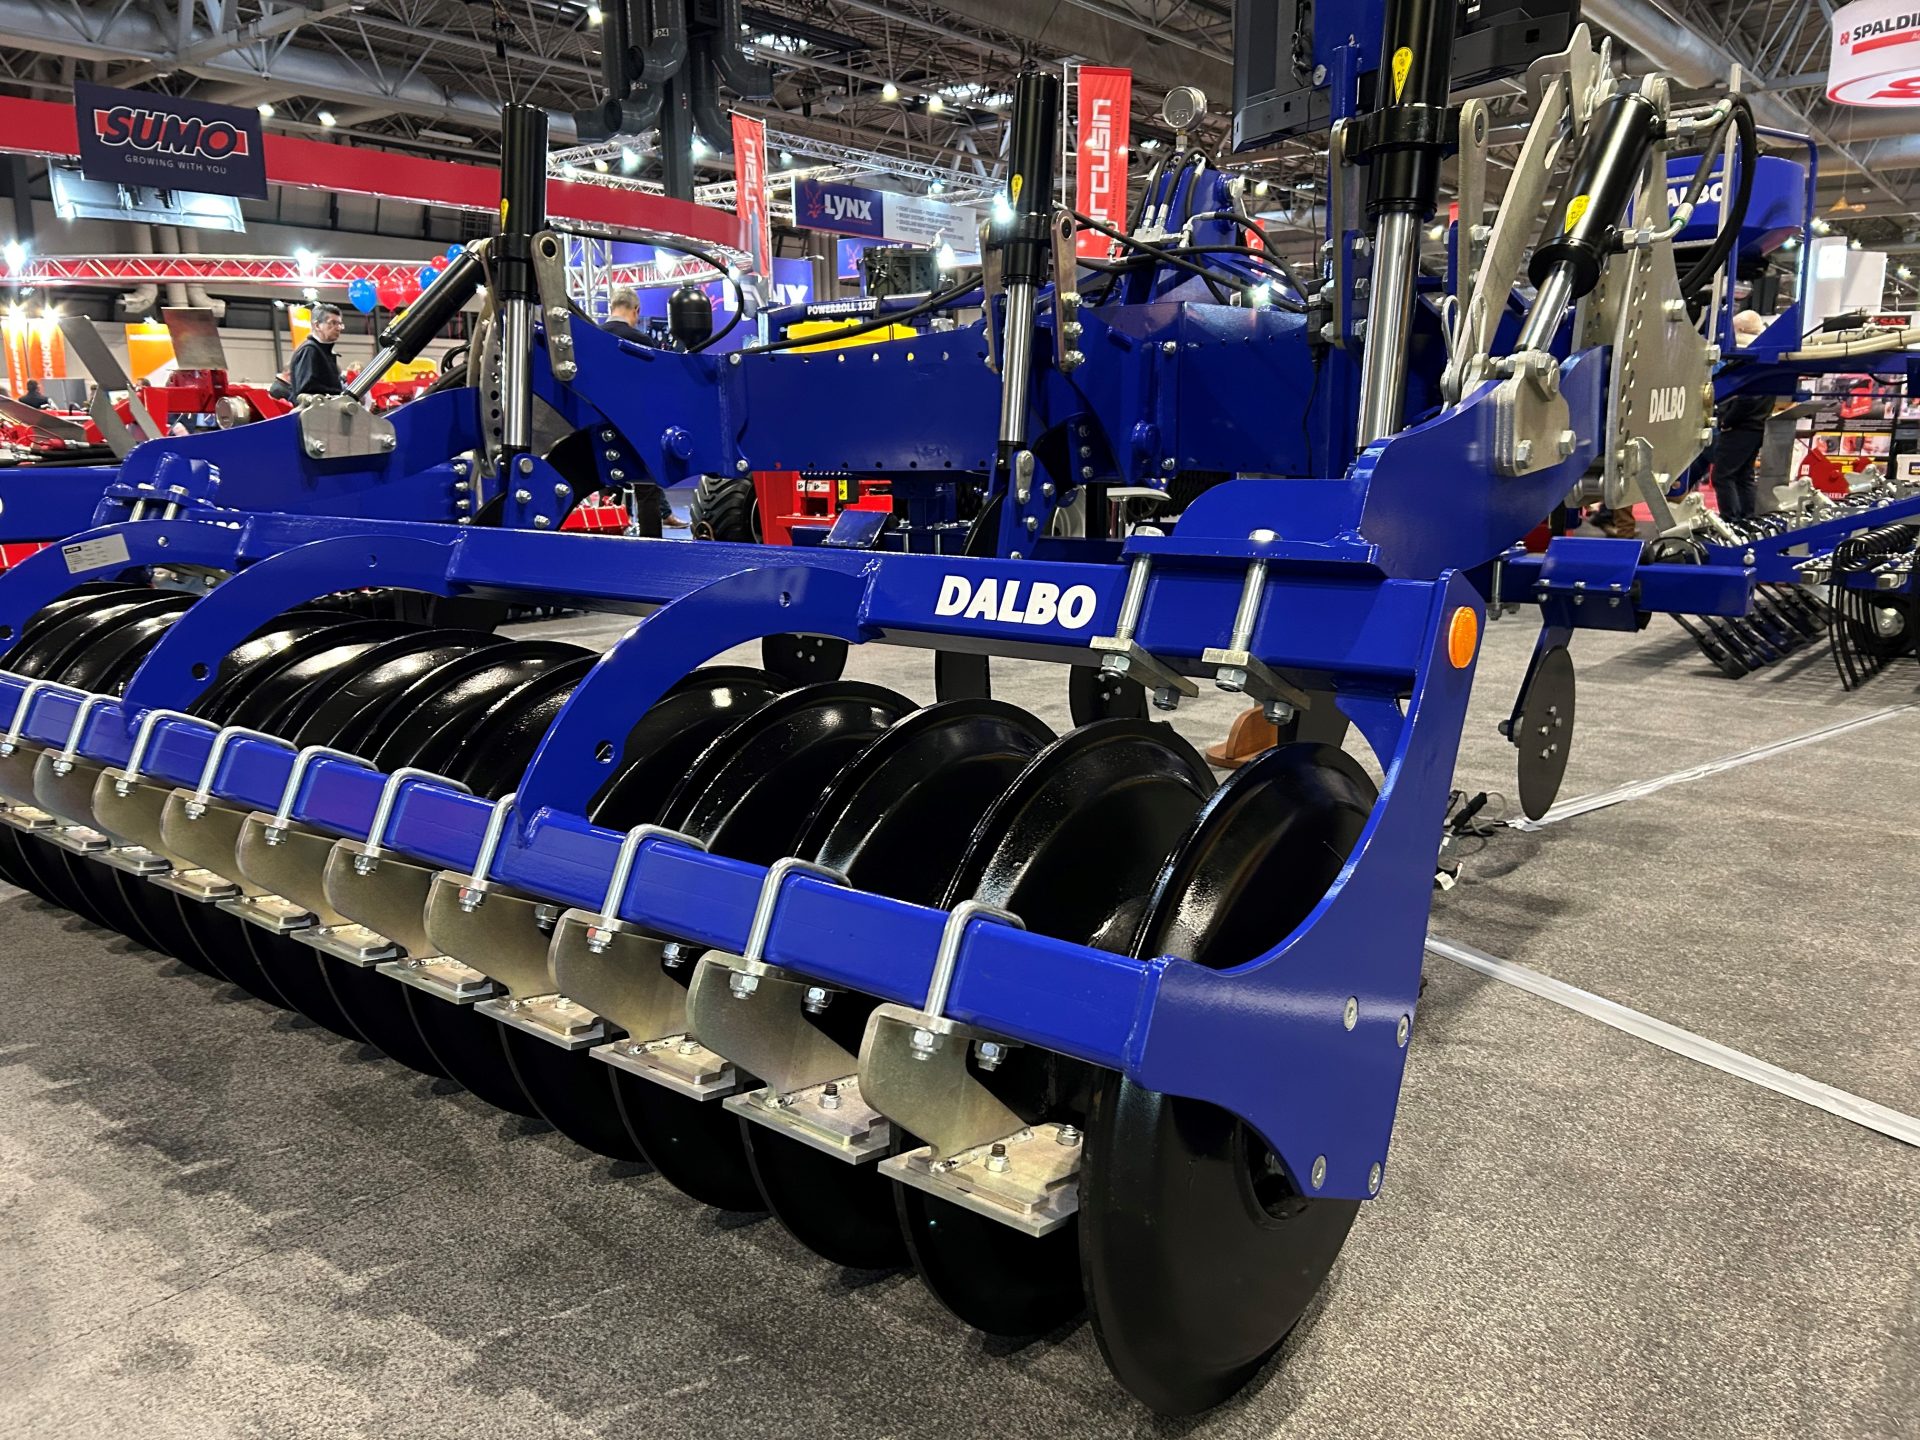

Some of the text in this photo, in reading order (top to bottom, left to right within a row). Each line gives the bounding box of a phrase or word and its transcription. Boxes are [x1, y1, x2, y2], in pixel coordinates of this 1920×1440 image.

[1853, 12, 1920, 41] SPALDI
[100, 106, 239, 159] SUMO
[124, 154, 227, 174] GROWING WITH YOU
[824, 194, 872, 221] LYNX
[722, 278, 808, 321] LNX
[807, 301, 857, 315] POWERROLL
[1648, 385, 1686, 423] DALBO
[934, 574, 1097, 630] DALBO
